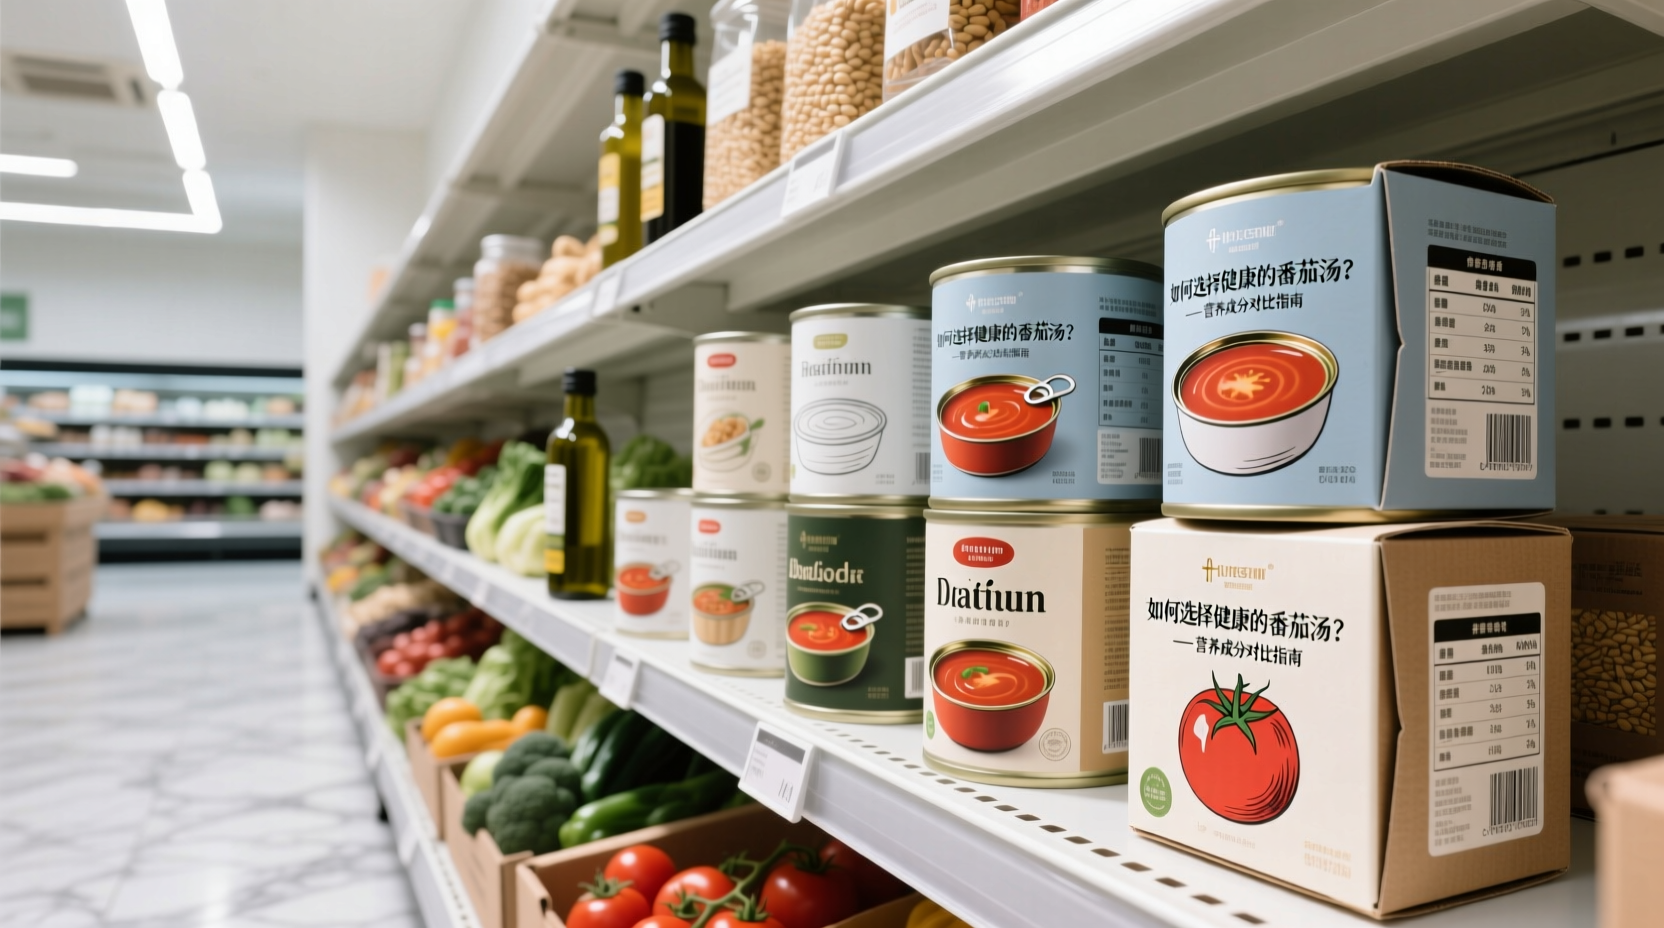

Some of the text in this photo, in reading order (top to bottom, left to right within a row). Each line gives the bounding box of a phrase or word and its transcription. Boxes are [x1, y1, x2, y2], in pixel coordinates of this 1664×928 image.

[1170, 257, 1354, 306] 如何选择健康的番茄汤?
[1146, 597, 1345, 643] 如何选择健康的番茄汤?
